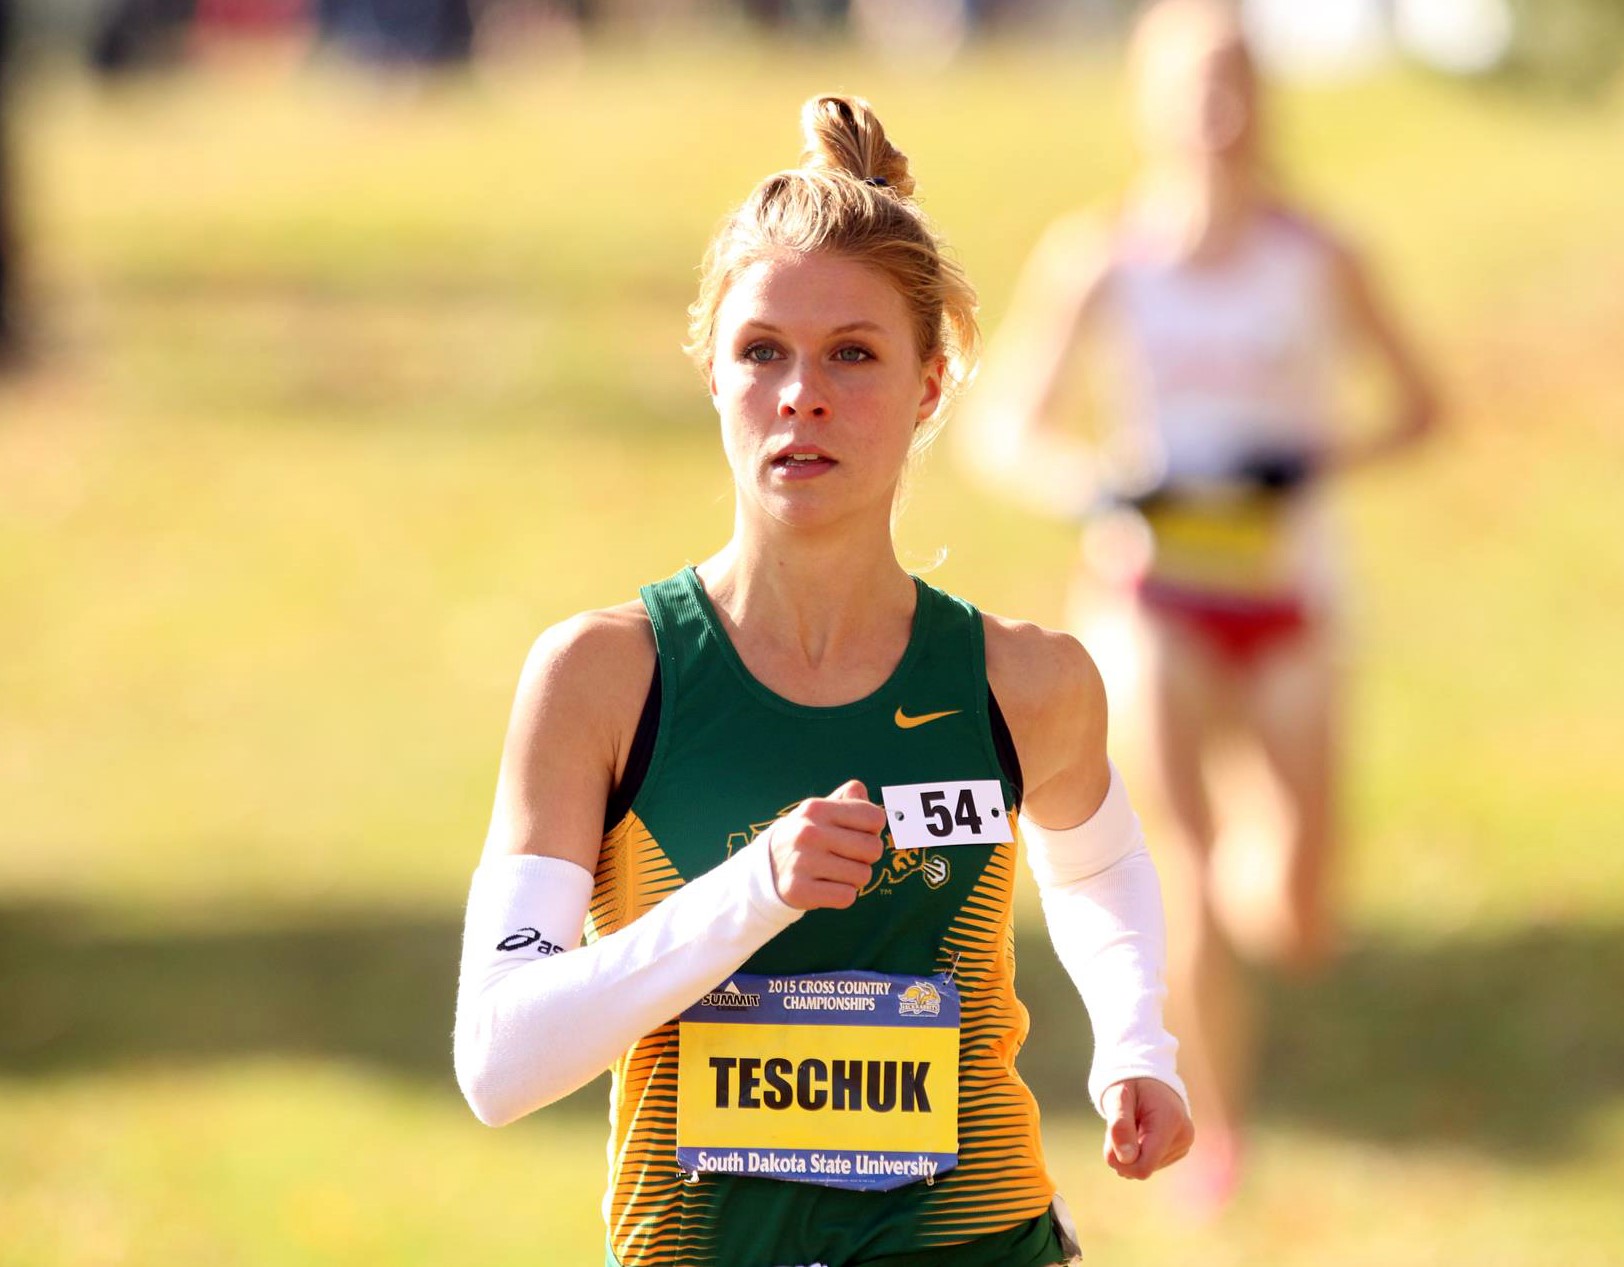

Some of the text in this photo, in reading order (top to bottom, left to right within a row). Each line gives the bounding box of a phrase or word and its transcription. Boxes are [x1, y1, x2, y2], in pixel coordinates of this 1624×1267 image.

[920, 788, 983, 838] 54
[768, 980, 892, 996] 2015 CROSS COUNTRY
[702, 993, 760, 1006] SUMMIT
[783, 997, 876, 1011] CHAMPIONSHIPS
[709, 1056, 932, 1113] TESCHUK
[697, 1151, 938, 1177] South Dakota State University
